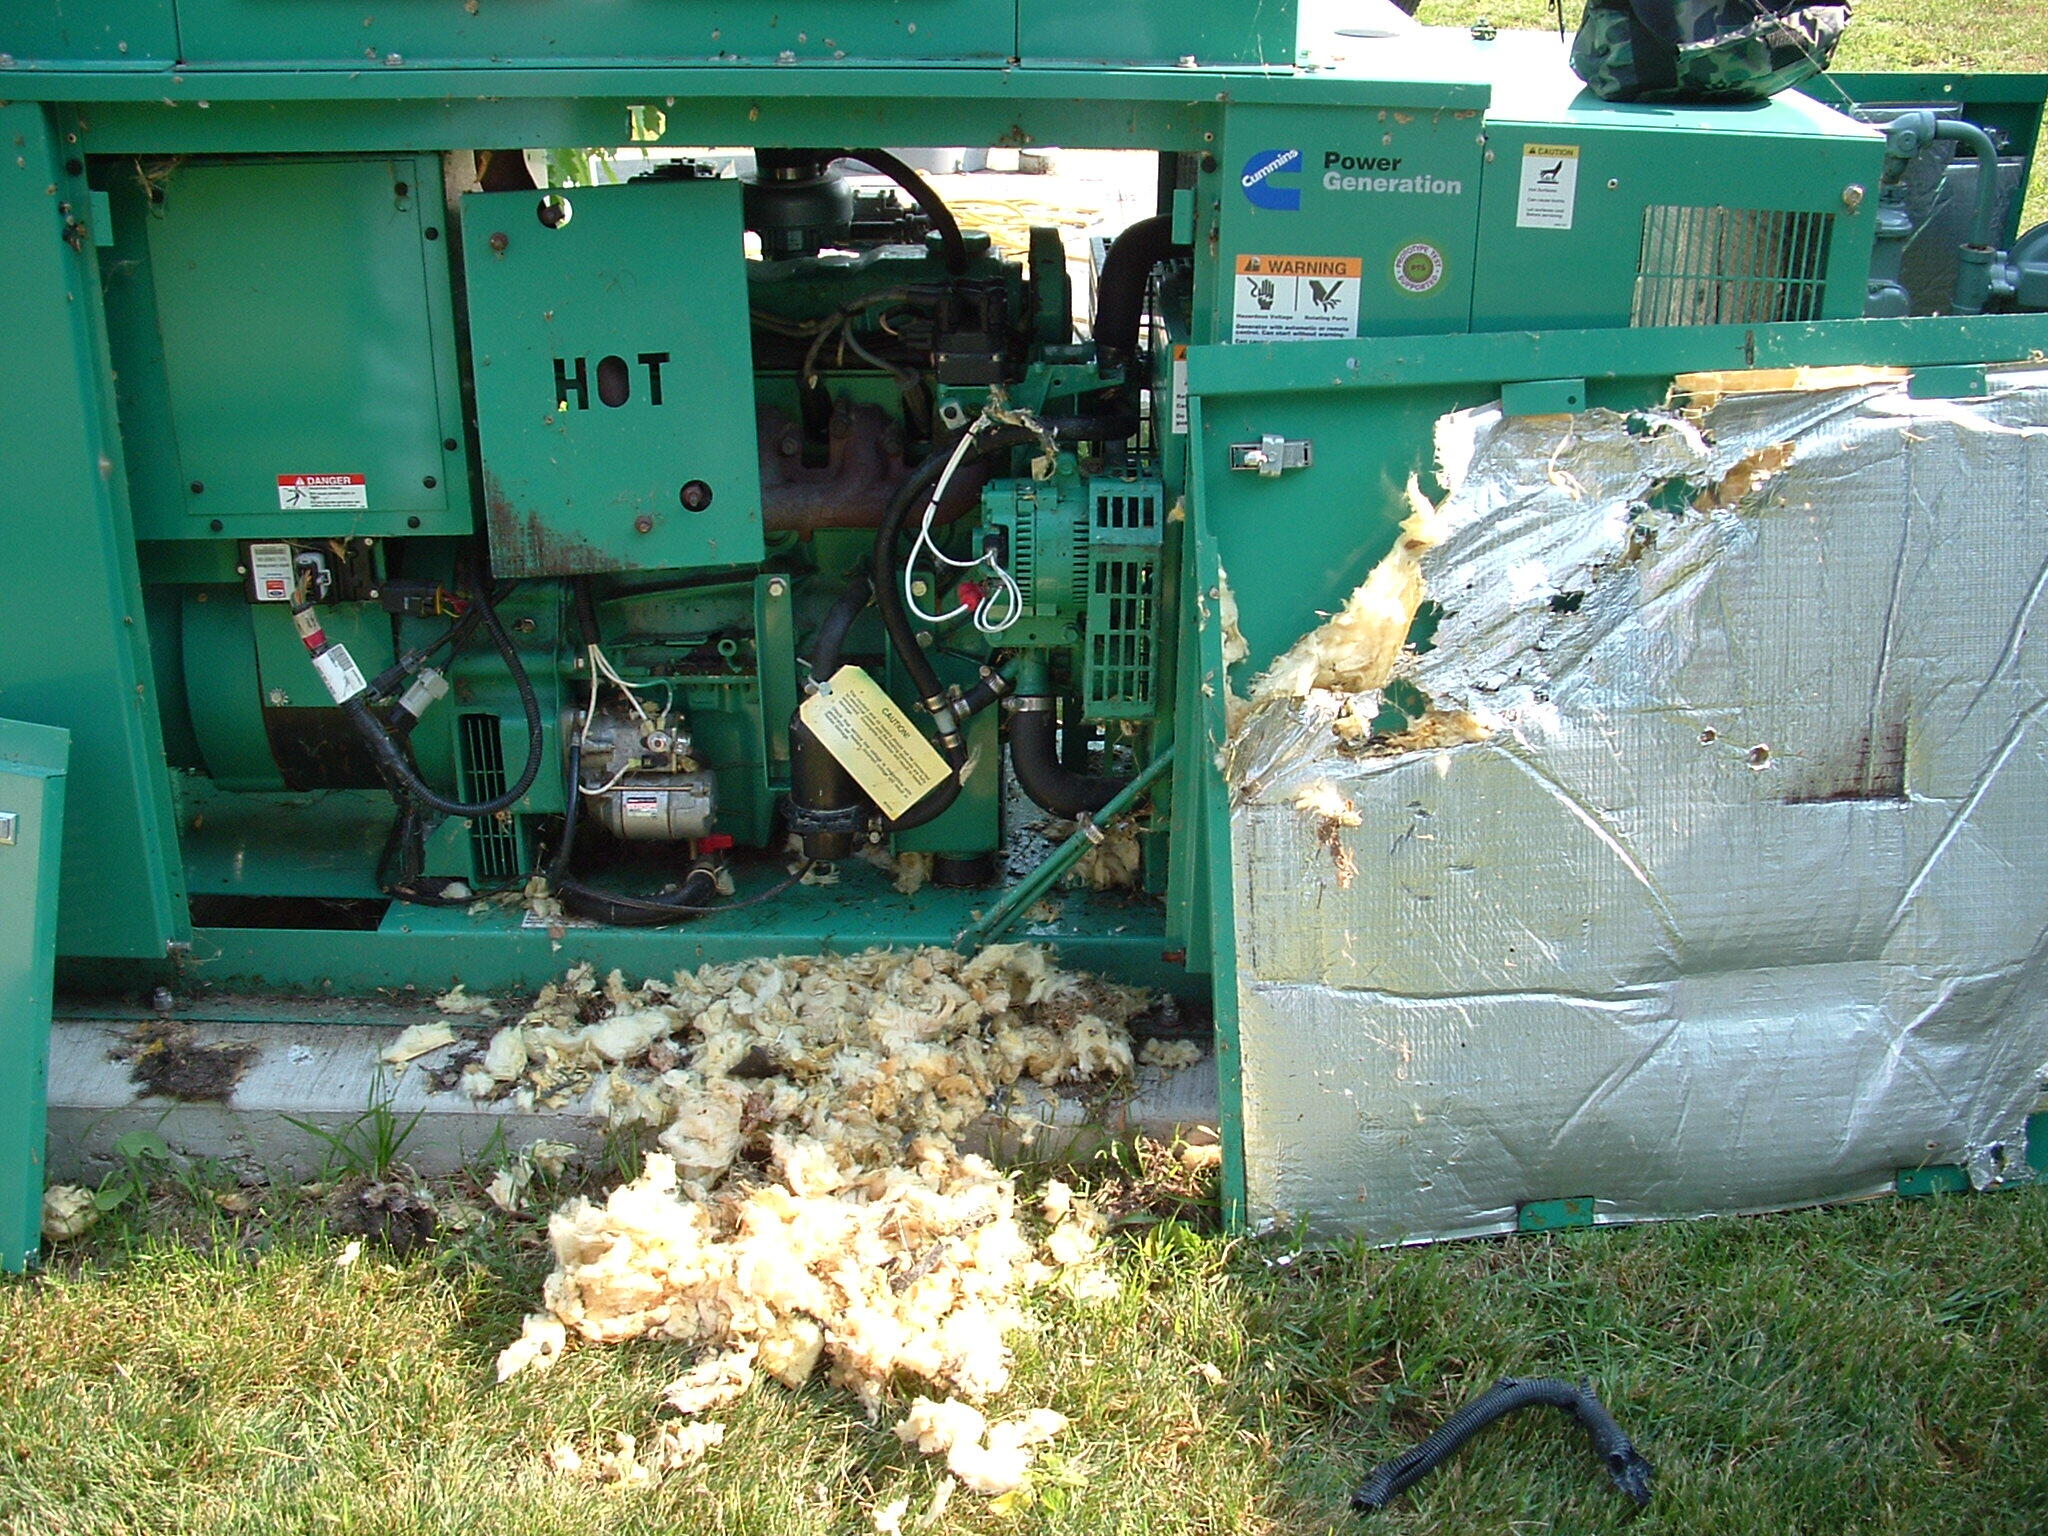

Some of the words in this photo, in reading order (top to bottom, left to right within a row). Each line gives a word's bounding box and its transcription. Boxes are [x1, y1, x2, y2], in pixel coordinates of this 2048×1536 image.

[1324, 151, 1402, 171] Power
[1538, 148, 1574, 156] CAUTION
[1241, 149, 1298, 187] Cummins
[1322, 171, 1462, 194] Generation
[1268, 260, 1347, 275] WARNING
[553, 352, 670, 410] HOT
[306, 476, 351, 485] DANGER
